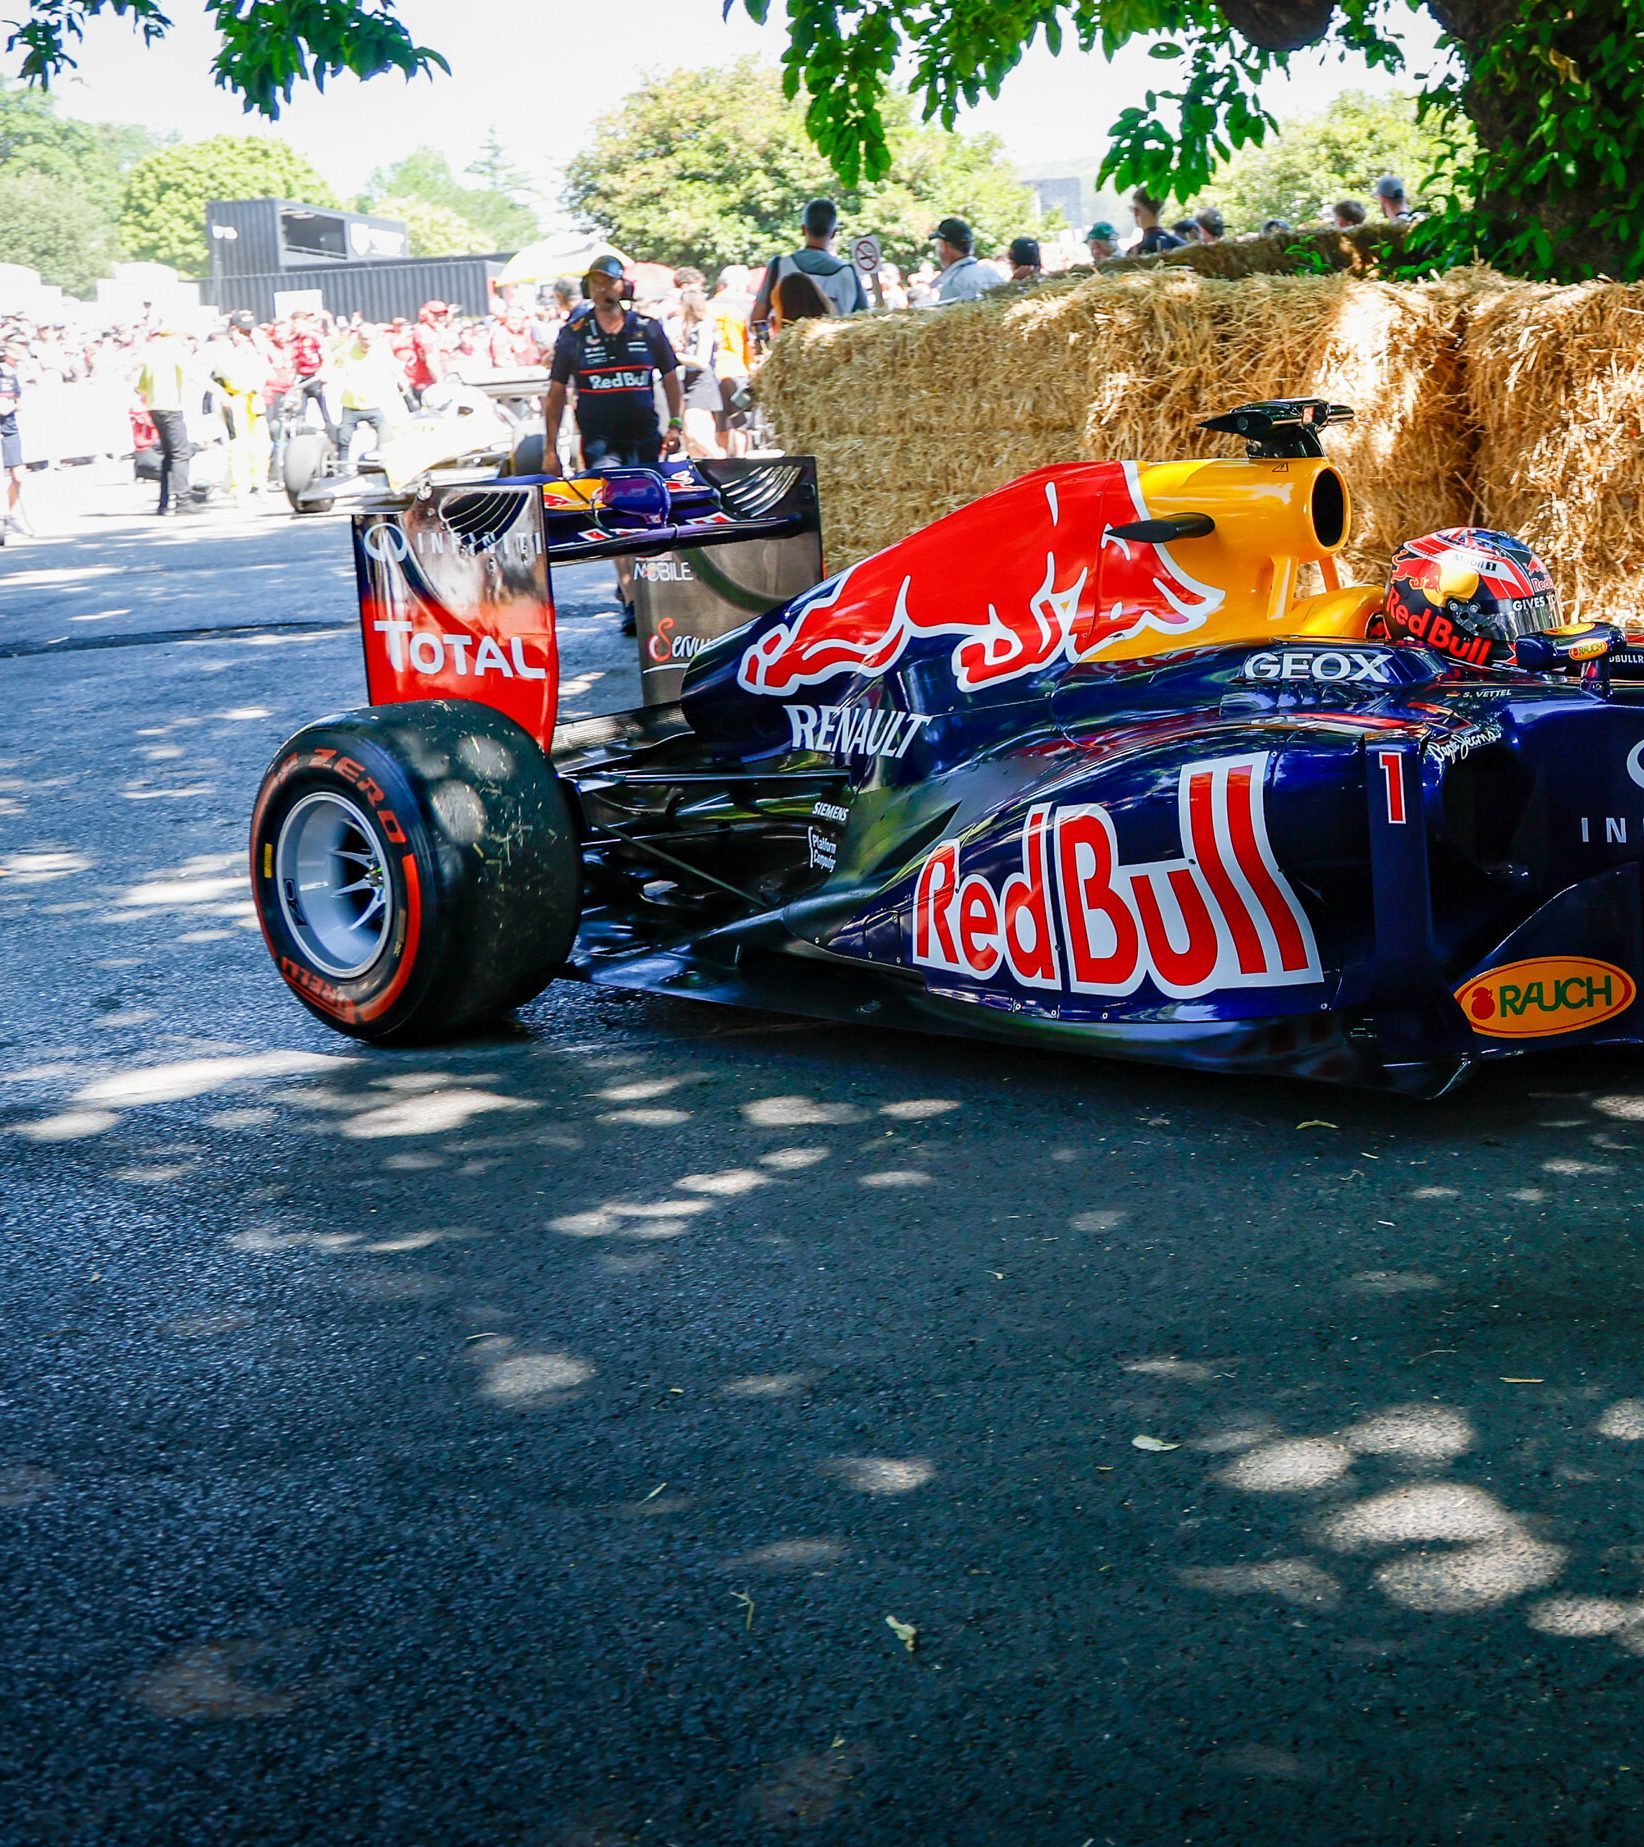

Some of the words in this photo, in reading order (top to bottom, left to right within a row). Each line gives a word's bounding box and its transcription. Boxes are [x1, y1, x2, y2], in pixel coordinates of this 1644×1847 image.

[416, 532, 542, 555] INFINITI
[633, 562, 694, 582] MOBILE
[1512, 595, 1546, 613] GIVES
[373, 620, 547, 680] TOTAL
[1578, 642, 1604, 655] RAUCH
[1244, 652, 1394, 684] GEOX
[1462, 691, 1473, 699] S.
[1475, 688, 1512, 698] VETTEL
[782, 704, 934, 759] RENAULT
[308, 748, 407, 844] ZERO
[1379, 751, 1407, 825] 1
[812, 801, 850, 822] SIEMENS
[1499, 975, 1613, 1018] RAUCH
